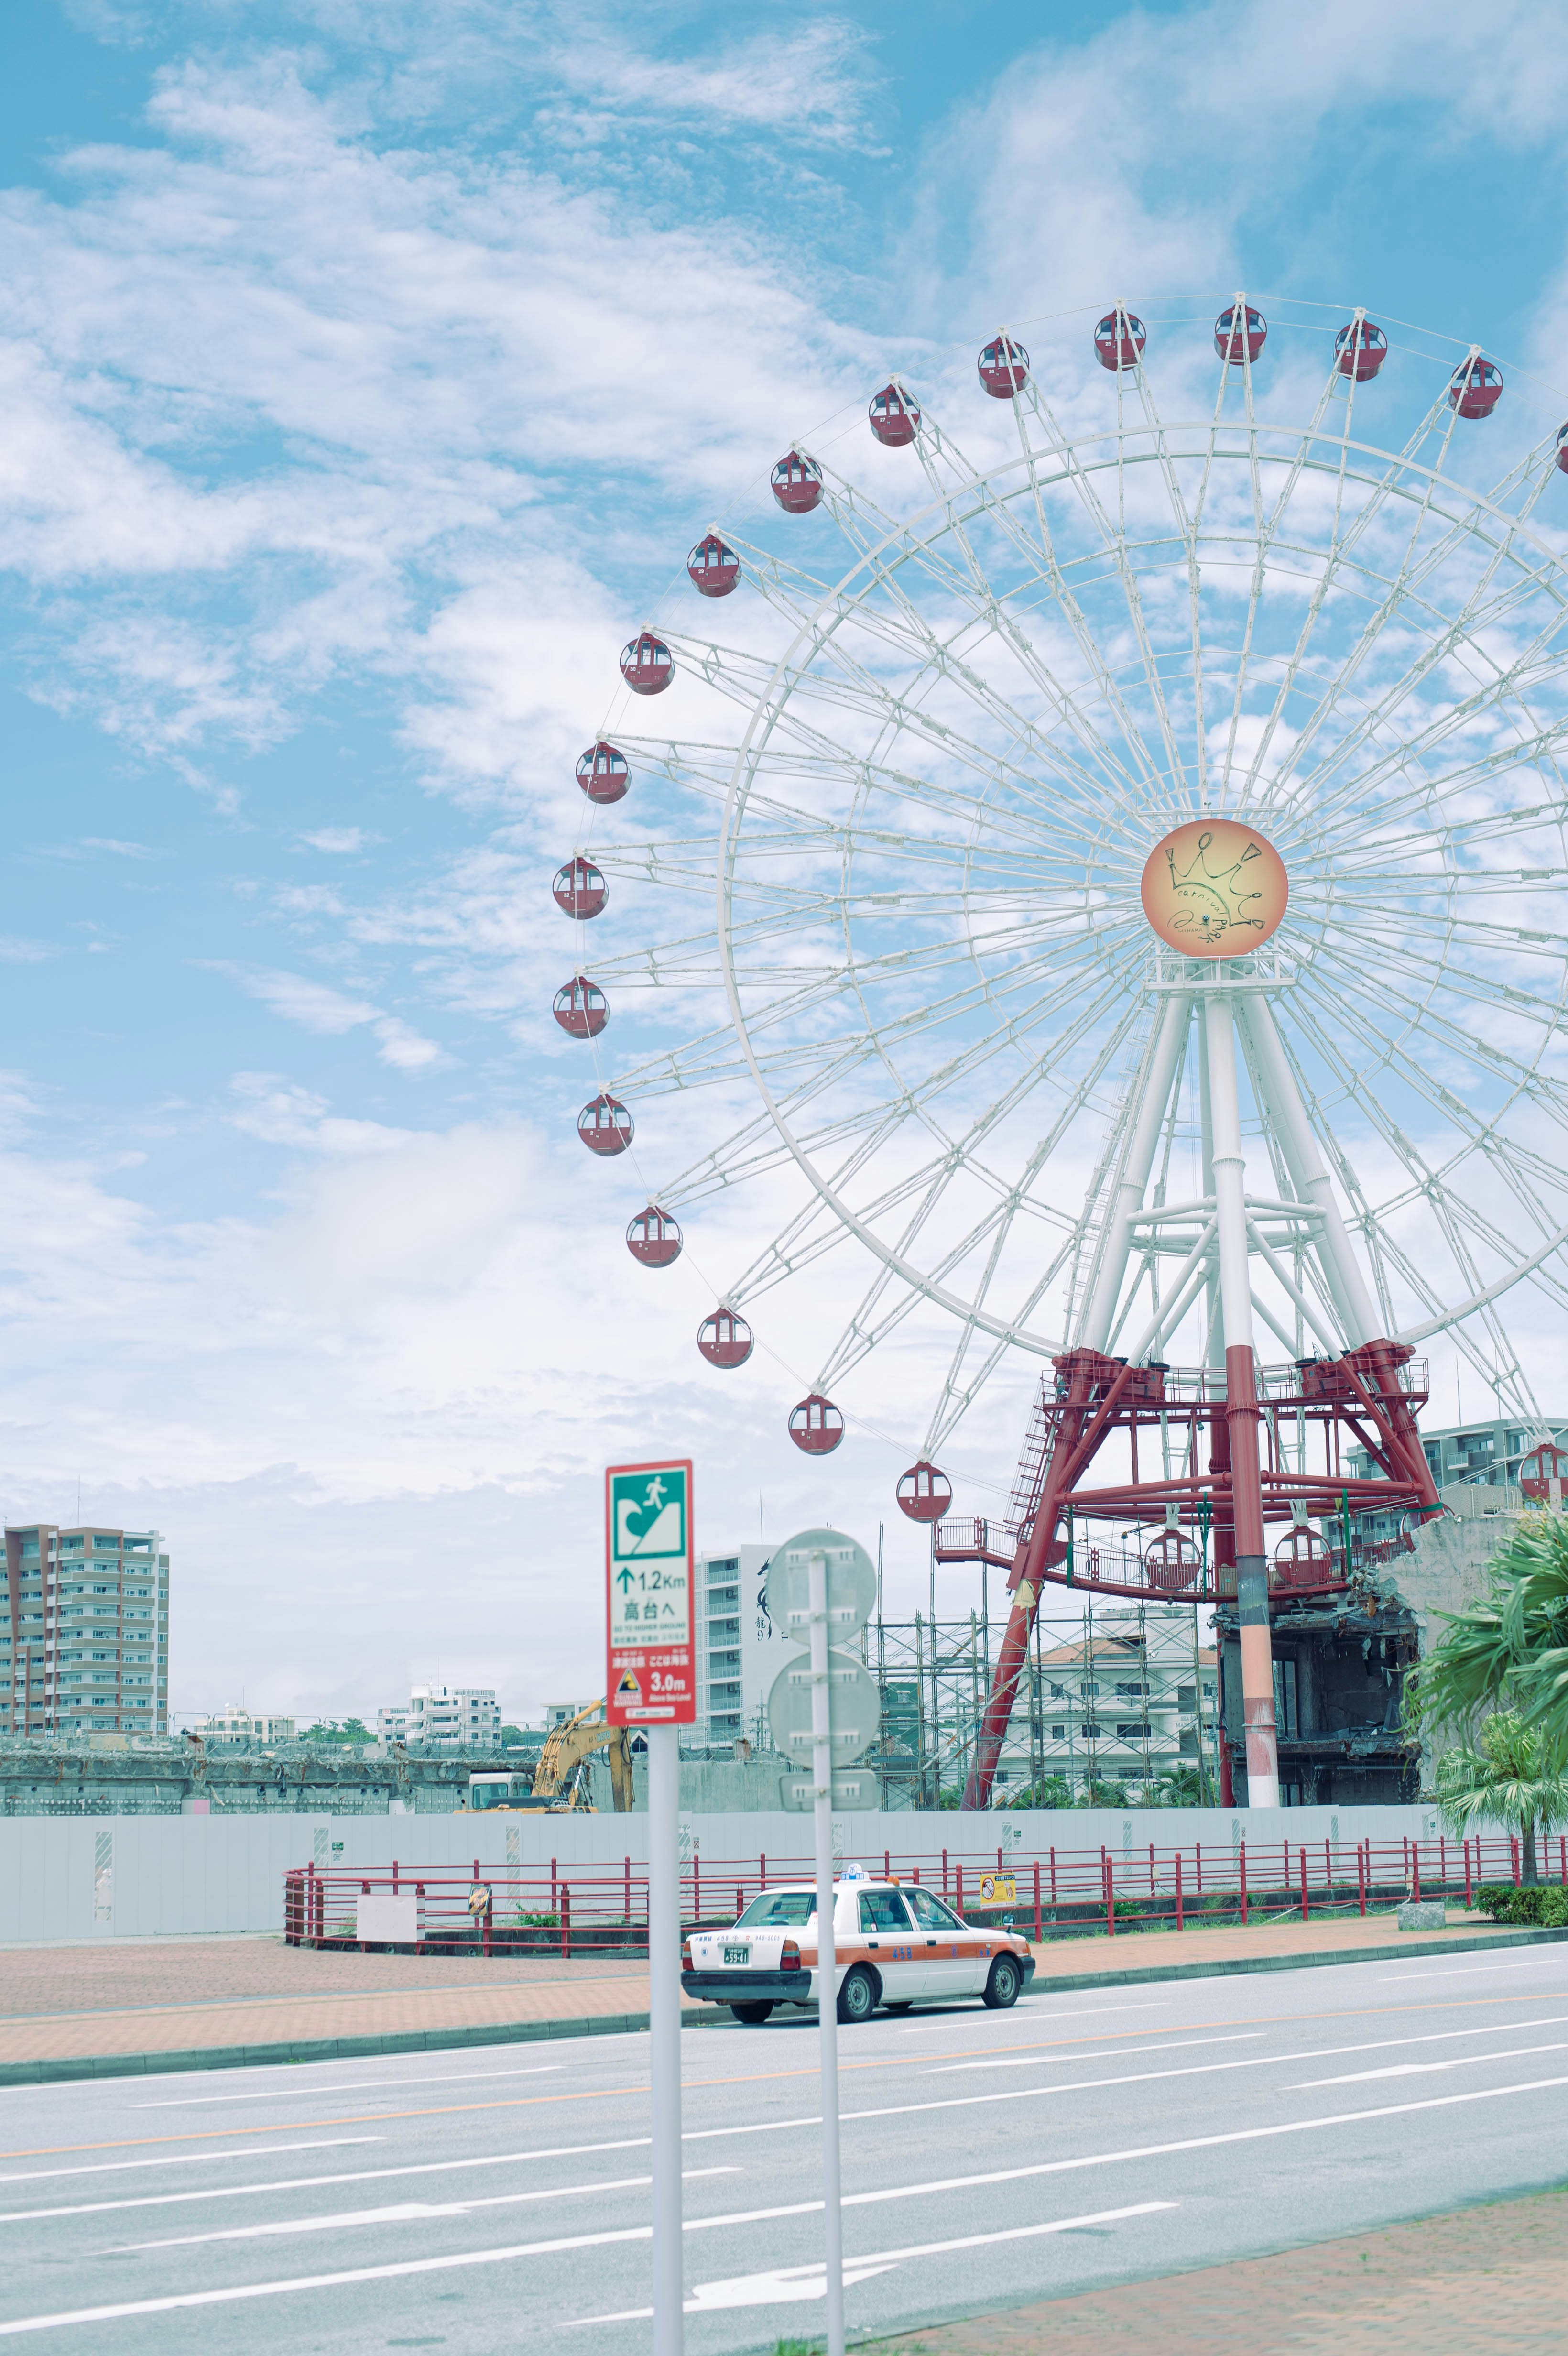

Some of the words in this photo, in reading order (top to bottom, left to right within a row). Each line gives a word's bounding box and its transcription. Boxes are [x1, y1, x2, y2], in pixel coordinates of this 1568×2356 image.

[1178, 891, 1228, 915] carnival
[1198, 919, 1228, 943] PARK
[639, 1571, 686, 1591] 1.2Km
[625, 1601, 675, 1621] 高台へ
[757, 1630, 763, 1641] 9
[650, 1671, 686, 1691] 3.0m
[597, 1730, 610, 1743] KATO
[892, 1947, 912, 1960] 458
